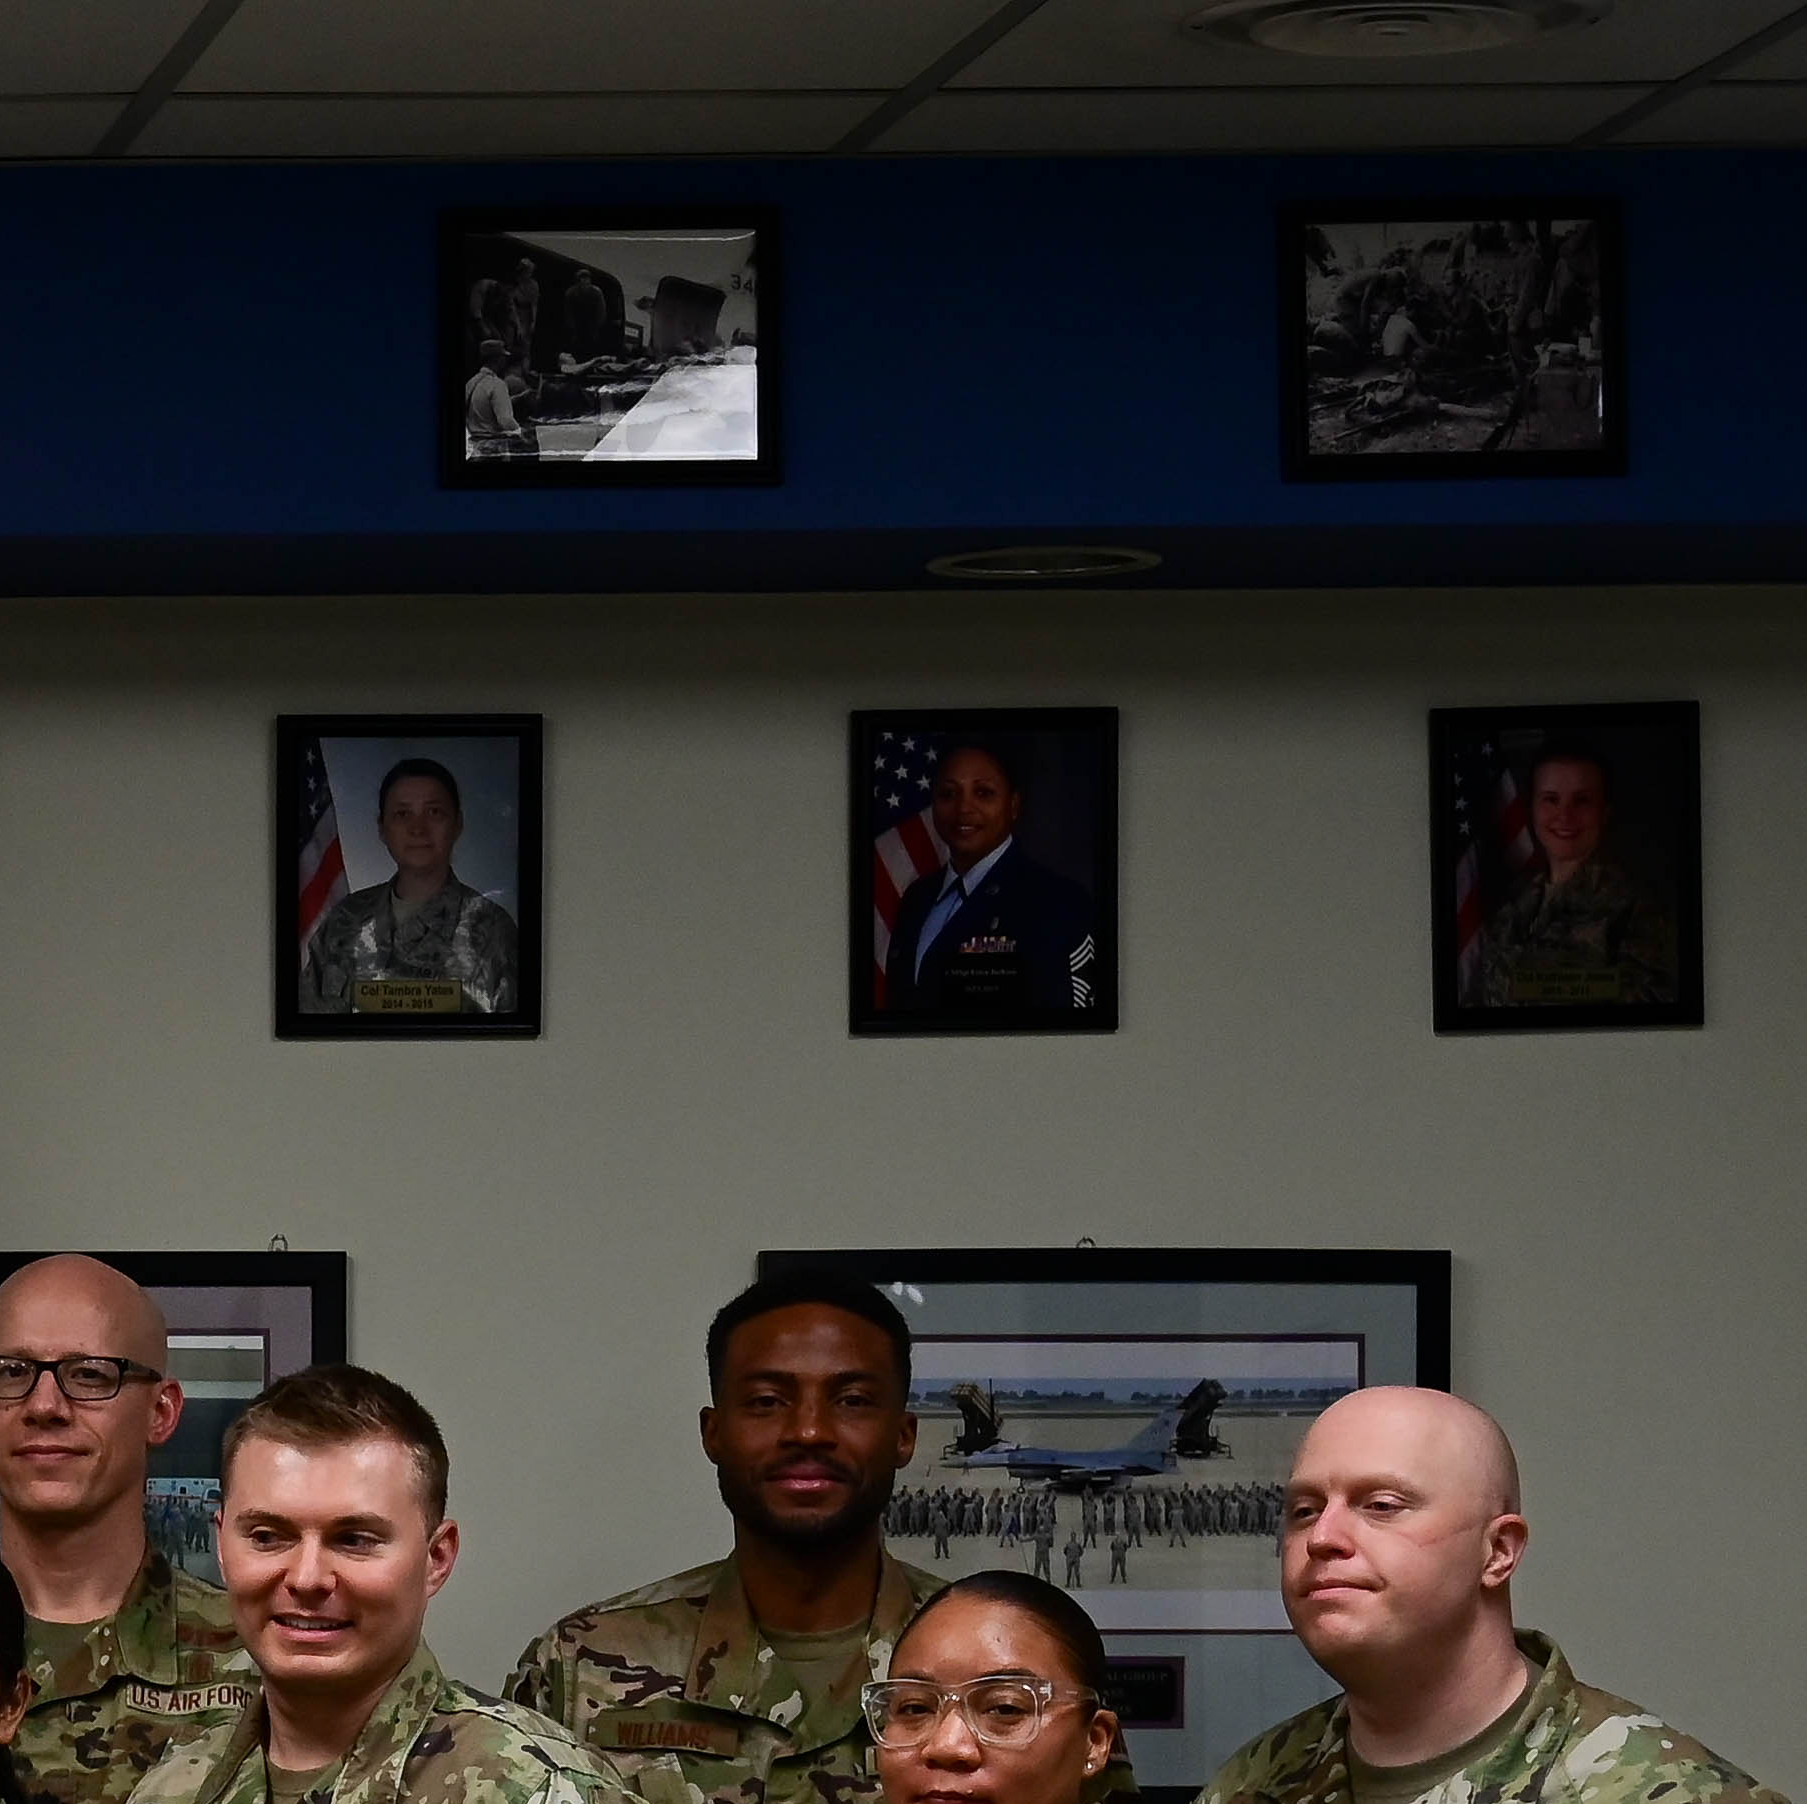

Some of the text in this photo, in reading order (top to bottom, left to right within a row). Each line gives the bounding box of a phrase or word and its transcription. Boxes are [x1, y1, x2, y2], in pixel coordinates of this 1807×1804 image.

[361, 984, 379, 996] Col
[383, 984, 422, 996] Tambra
[132, 1685, 161, 1710] U.S.
[168, 1691, 201, 1712] AIR
[617, 1721, 712, 1749] WILLIAMS
